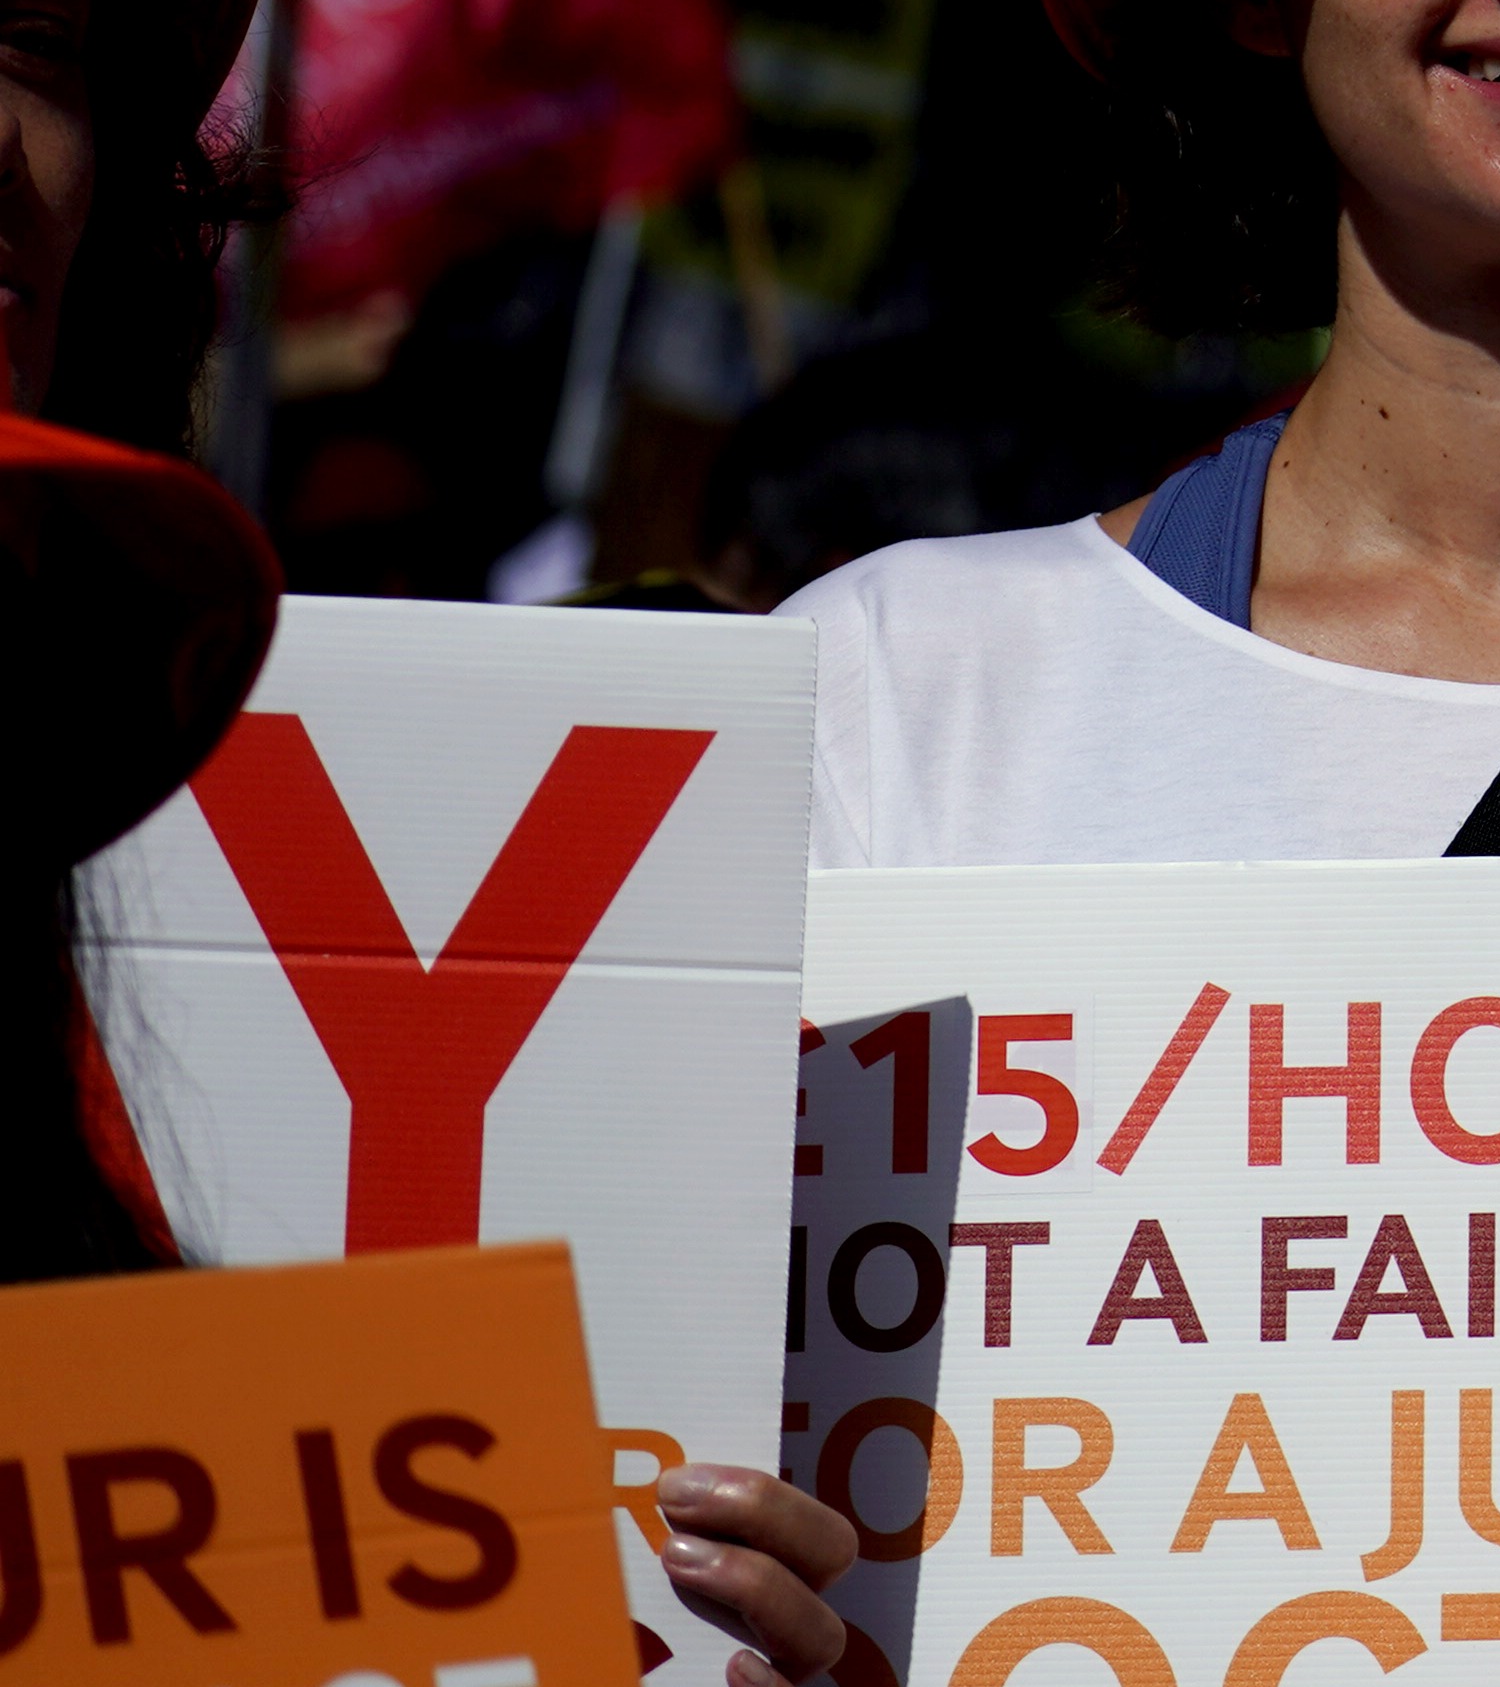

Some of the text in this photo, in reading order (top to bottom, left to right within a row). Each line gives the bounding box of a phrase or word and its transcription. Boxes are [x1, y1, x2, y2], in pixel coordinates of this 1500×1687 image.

[1087, 1220, 1207, 1345] A
[295, 1413, 519, 1622] IS
[780, 1397, 1115, 1562] OR
[1171, 1393, 1321, 1552] A
